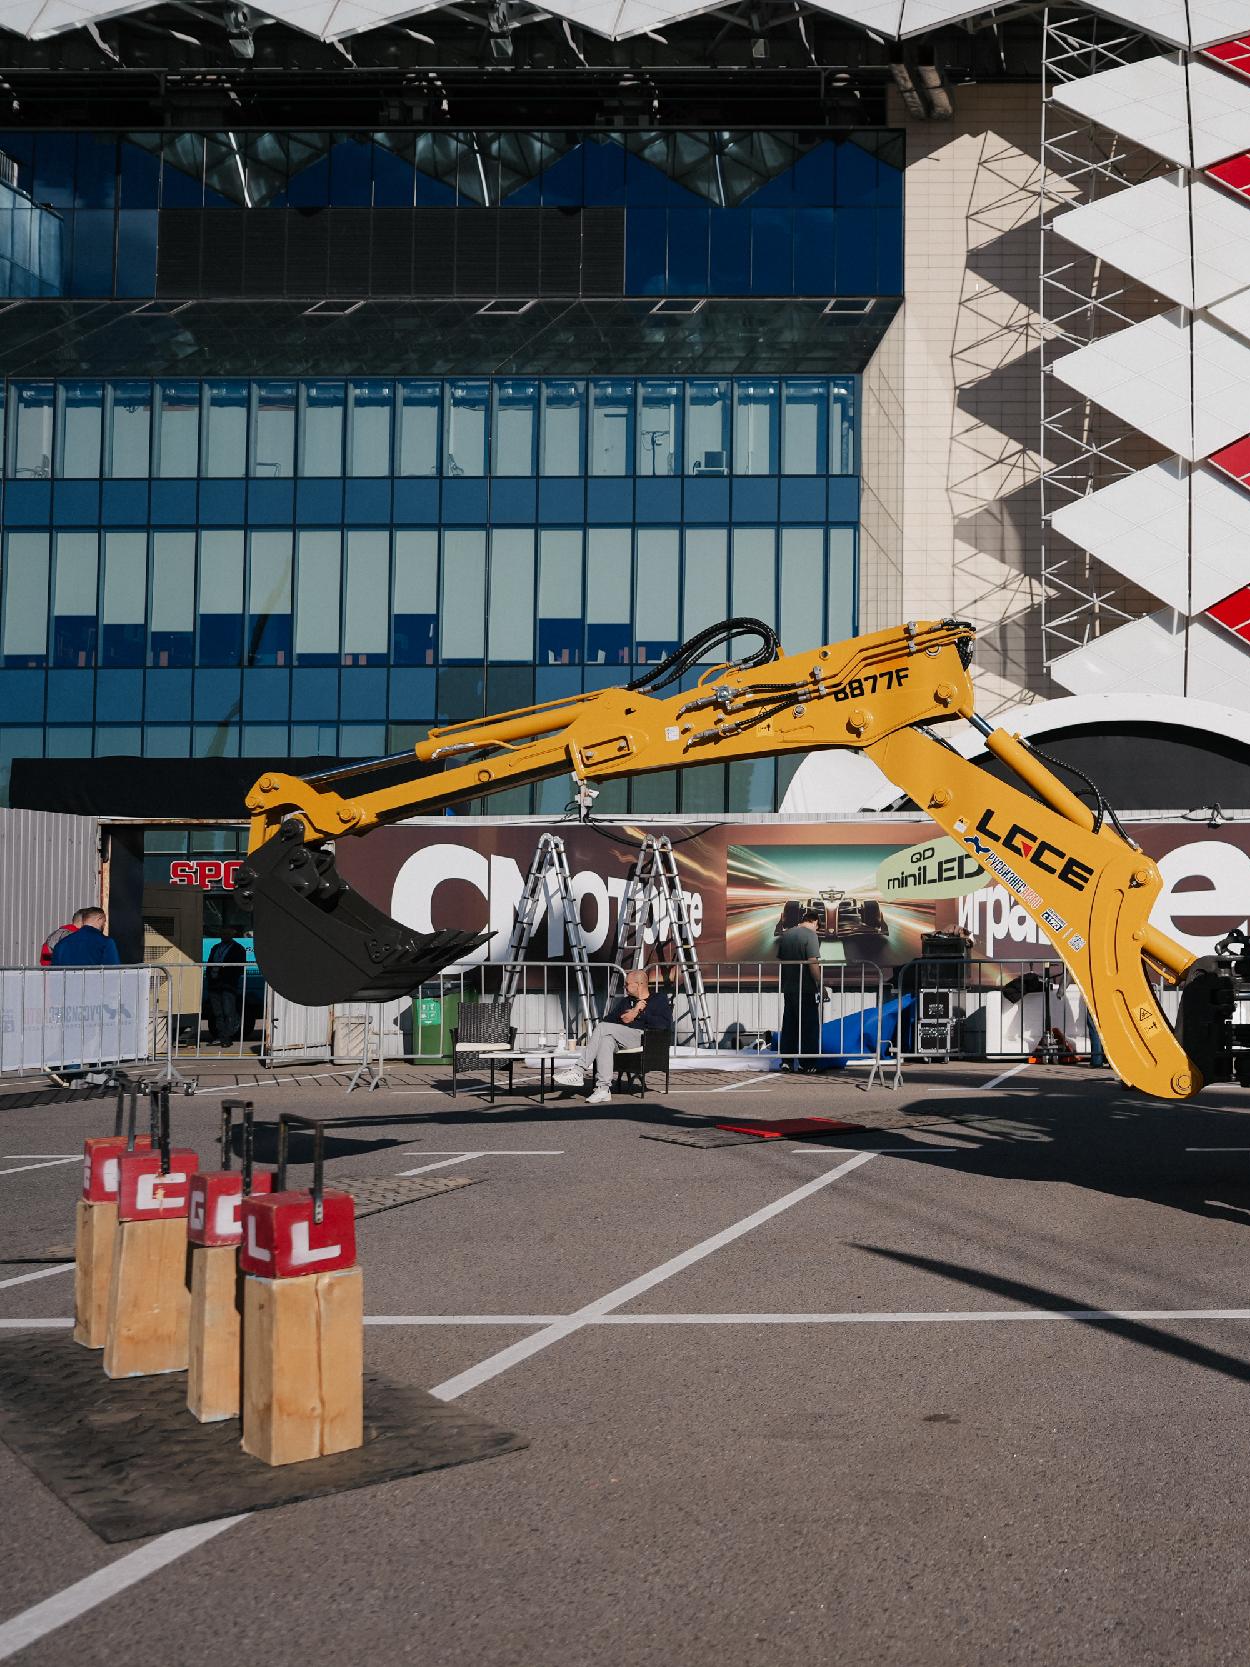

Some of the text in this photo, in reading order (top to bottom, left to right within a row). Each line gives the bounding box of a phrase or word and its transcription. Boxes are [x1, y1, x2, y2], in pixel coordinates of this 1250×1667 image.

[887, 853, 986, 890] miniLED
[911, 847, 936, 864] QD
[247, 1214, 271, 1262] L
[291, 1220, 342, 1266] L
